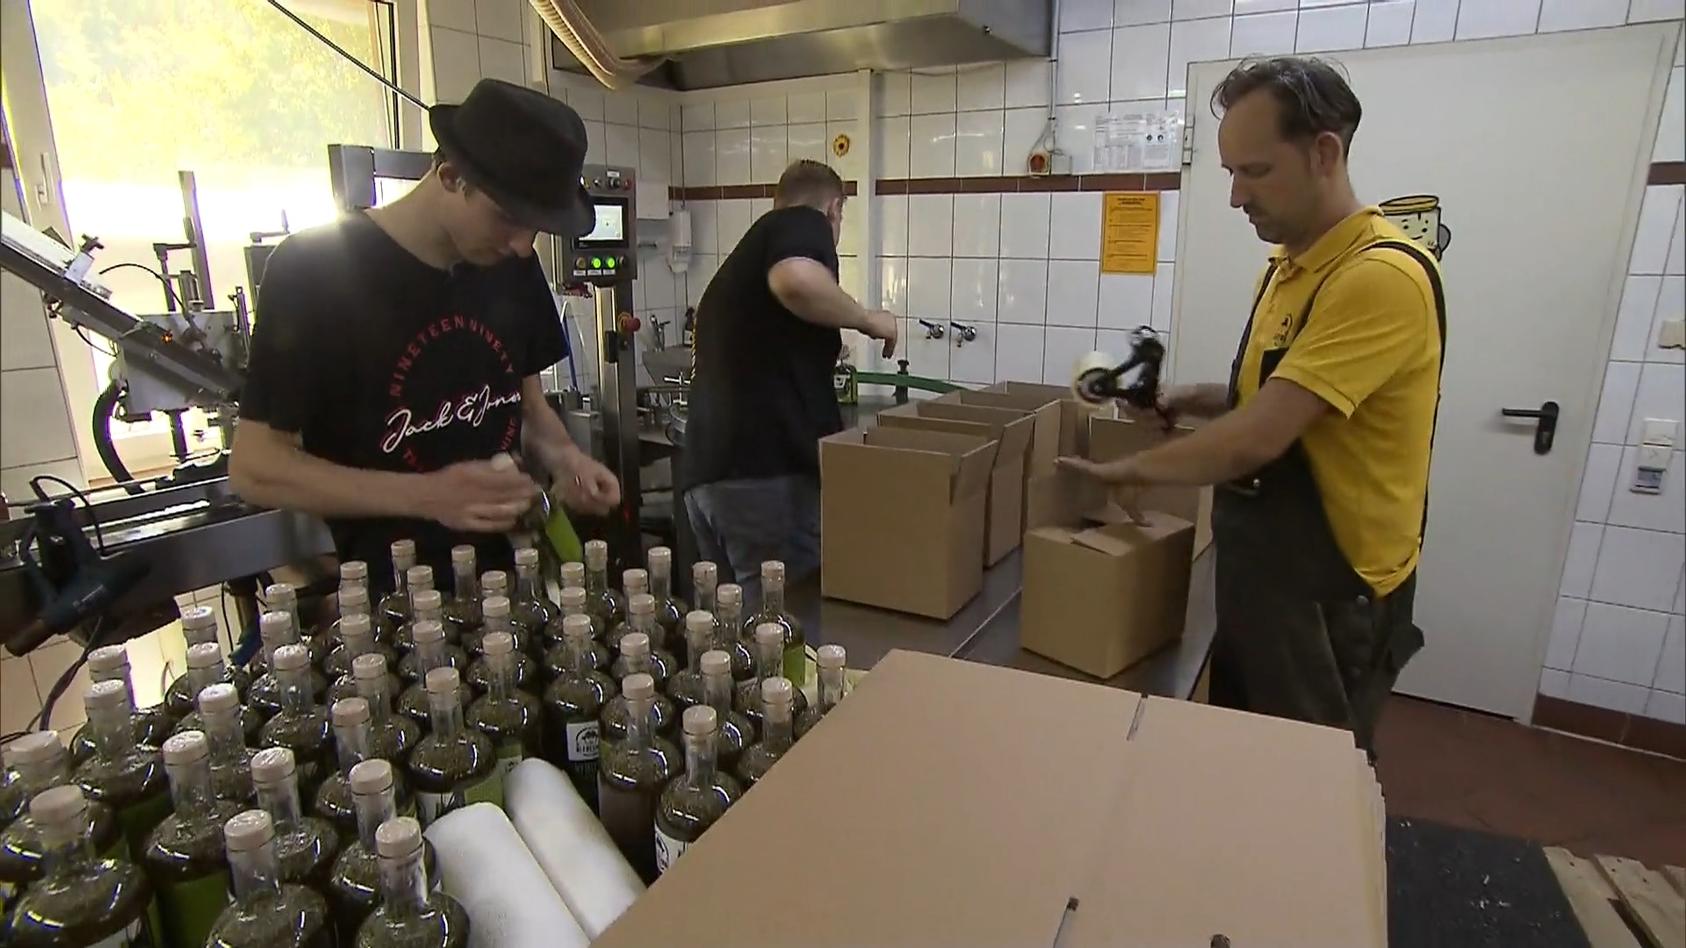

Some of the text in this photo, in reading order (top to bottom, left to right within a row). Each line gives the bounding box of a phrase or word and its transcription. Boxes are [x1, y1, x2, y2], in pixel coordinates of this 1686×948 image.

[389, 314, 514, 398] NINETEEN NINETY
[382, 401, 454, 453] Jack
[456, 392, 478, 421] &
